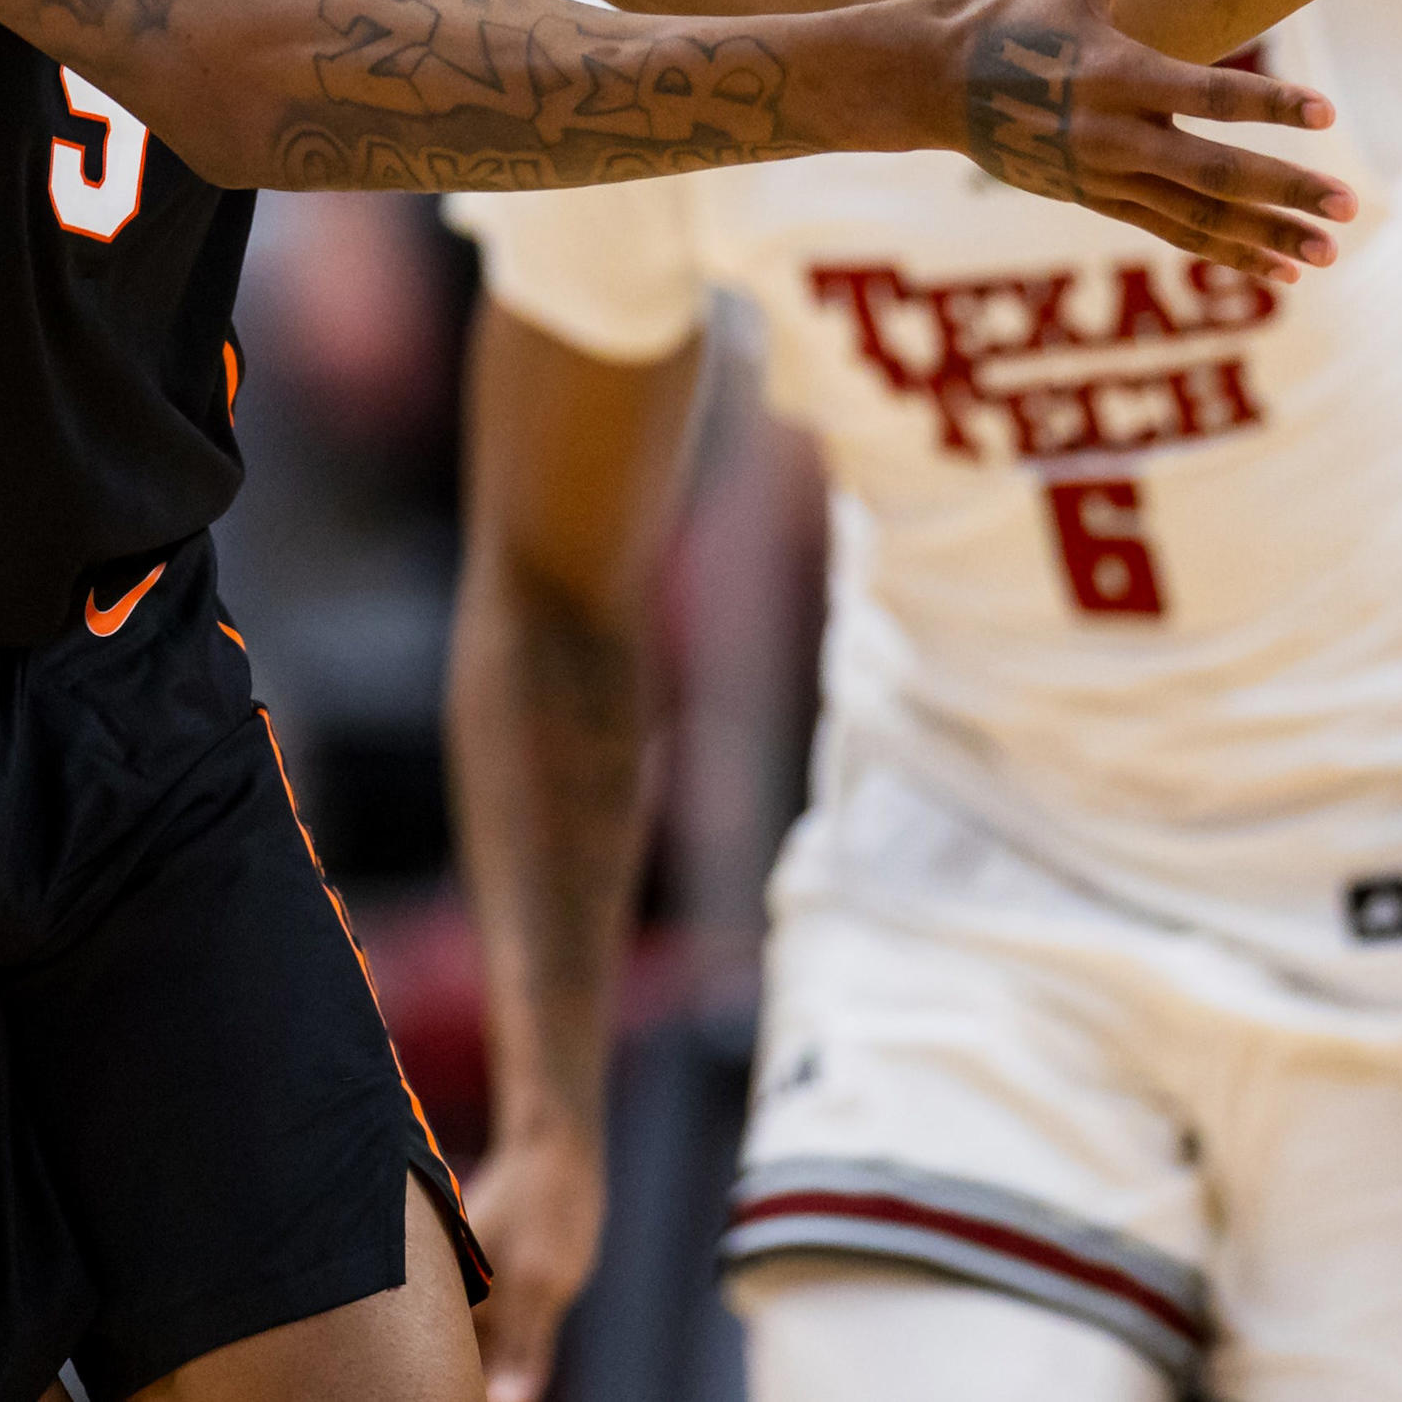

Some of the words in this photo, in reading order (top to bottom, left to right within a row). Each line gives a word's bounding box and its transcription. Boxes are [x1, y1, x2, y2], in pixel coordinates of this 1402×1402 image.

[808, 256, 1280, 383] TEXAS
[898, 355, 1266, 465] TECH
[1046, 478, 1166, 619] 6
